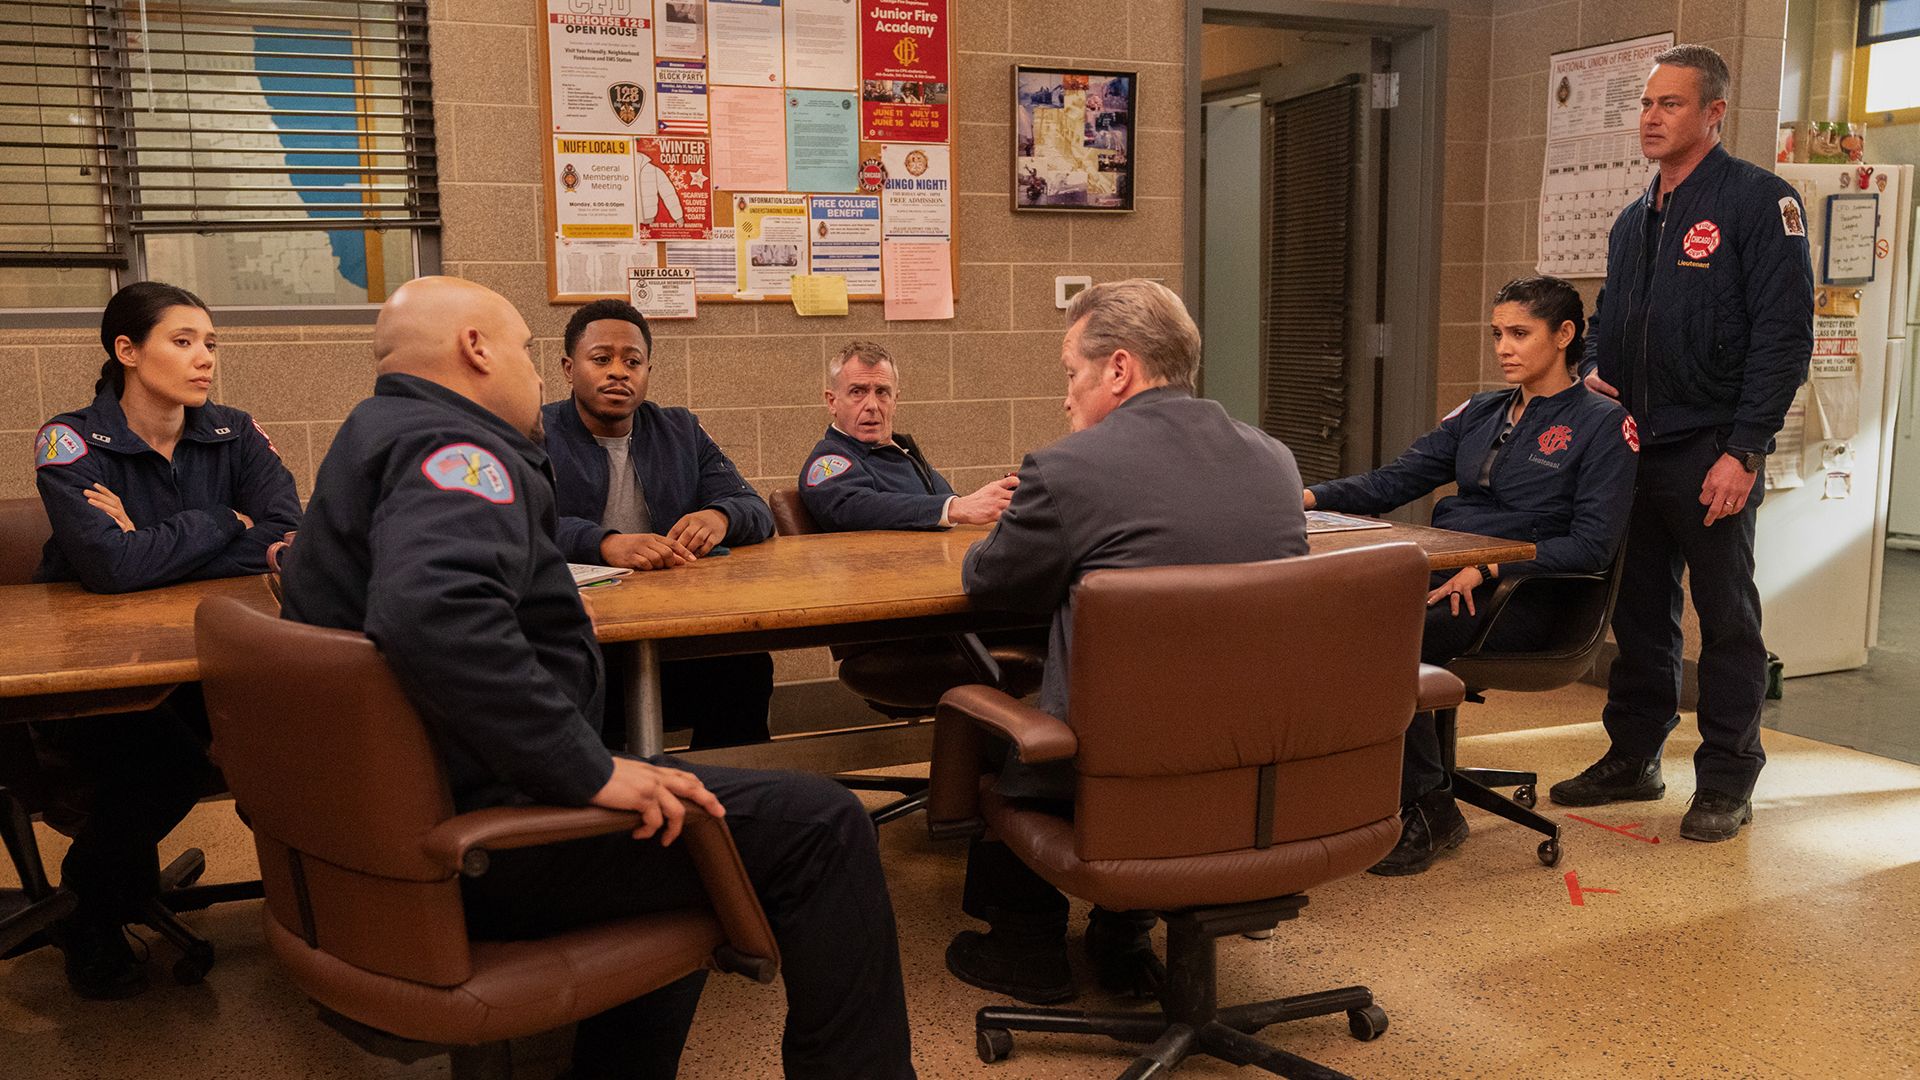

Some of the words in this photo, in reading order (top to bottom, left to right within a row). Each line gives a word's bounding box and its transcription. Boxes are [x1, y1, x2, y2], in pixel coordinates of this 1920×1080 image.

[870, 7, 912, 20] Junior
[915, 10, 938, 22] Fire
[557, 15, 620, 27] FIREHOUSE
[623, 19, 645, 28] 128
[566, 25, 597, 34] OPEN
[600, 26, 638, 37] HOUSE
[875, 20, 934, 38] Academy
[1556, 61, 1586, 74] NATIONAL
[1588, 56, 1609, 68] UNION
[1610, 57, 1617, 67] of
[1618, 52, 1632, 64] FIRE
[658, 72, 681, 81] BLOCK
[682, 73, 705, 82] PARTY
[614, 86, 640, 102] 128
[872, 109, 895, 118] JUNE
[910, 111, 930, 119] JULY
[871, 119, 894, 127] JUNE
[909, 120, 930, 128] JULY
[563, 140, 587, 153] NUFF
[589, 141, 617, 154] LOCAL
[619, 141, 625, 154] 9
[659, 140, 706, 154] WINTER
[660, 154, 681, 165] COAT
[682, 155, 706, 165] DRIVE
[583, 173, 629, 182] Membership
[591, 183, 622, 191] Meeting
[885, 178, 914, 190] BINGO
[916, 179, 947, 191] NIGHT!
[813, 199, 837, 208] FREE
[838, 199, 878, 209] COLLEGE
[827, 209, 865, 218] BENEFIT
[1691, 235, 1711, 244] CHICAGO
[1677, 259, 1710, 269] Lieutenant
[633, 269, 655, 277] NUFF
[657, 269, 684, 277] LOCAL
[685, 269, 690, 277] 9
[1816, 320, 1839, 328] PROTECT
[1839, 320, 1856, 328] EVERY
[1814, 329, 1830, 337] CLASS
[1830, 329, 1837, 337] OF
[1837, 329, 1857, 337] PEOPLE
[1527, 453, 1561, 469] Lieutenant
